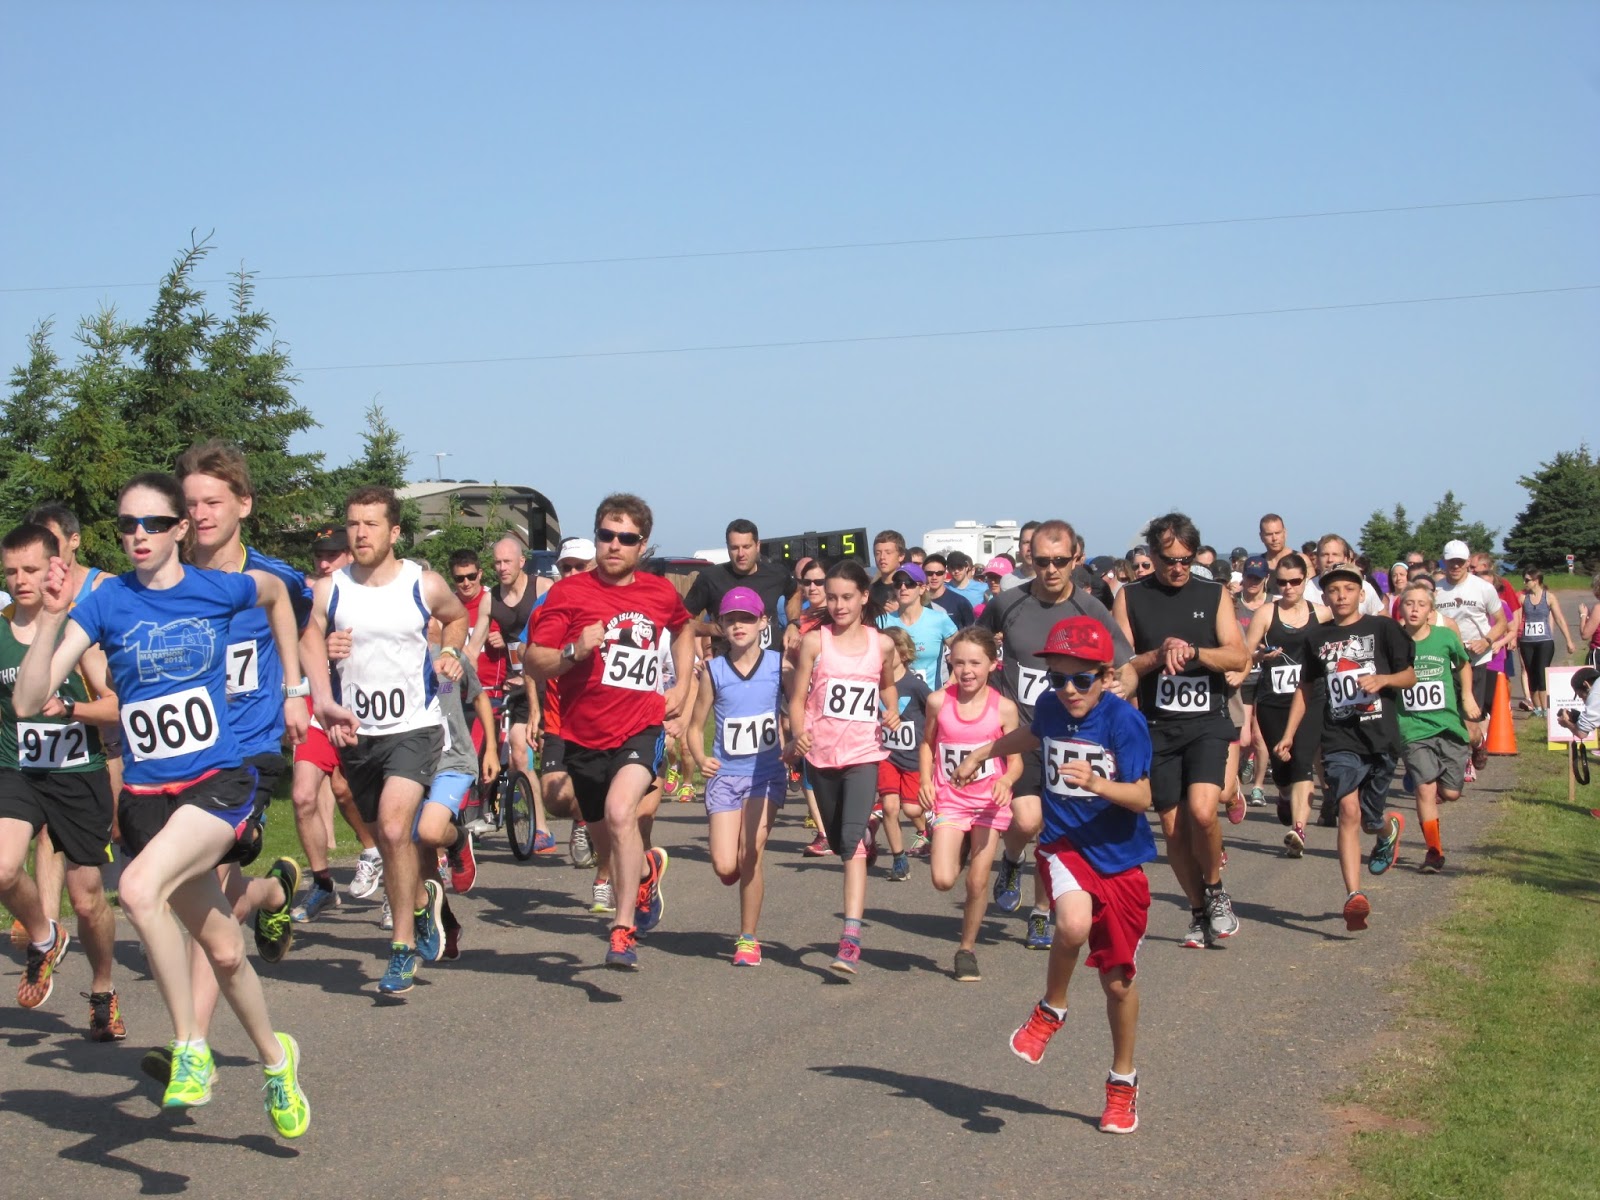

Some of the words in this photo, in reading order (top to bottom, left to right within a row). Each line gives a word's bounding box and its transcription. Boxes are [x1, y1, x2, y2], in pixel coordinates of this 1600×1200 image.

[843, 534, 855, 554] 5
[618, 611, 645, 622] ISLAND
[1526, 623, 1545, 635] 713
[139, 650, 184, 660] MARATHON
[164, 656, 184, 664] 2013
[226, 647, 254, 687] 7
[609, 650, 659, 686] 546
[354, 687, 406, 721] 900
[828, 684, 876, 717] 874
[1160, 678, 1209, 708] 968
[1331, 672, 1371, 704] 90
[1403, 684, 1442, 708] 906
[128, 696, 213, 754] 960
[727, 717, 777, 750] 716
[23, 728, 85, 763] 972
